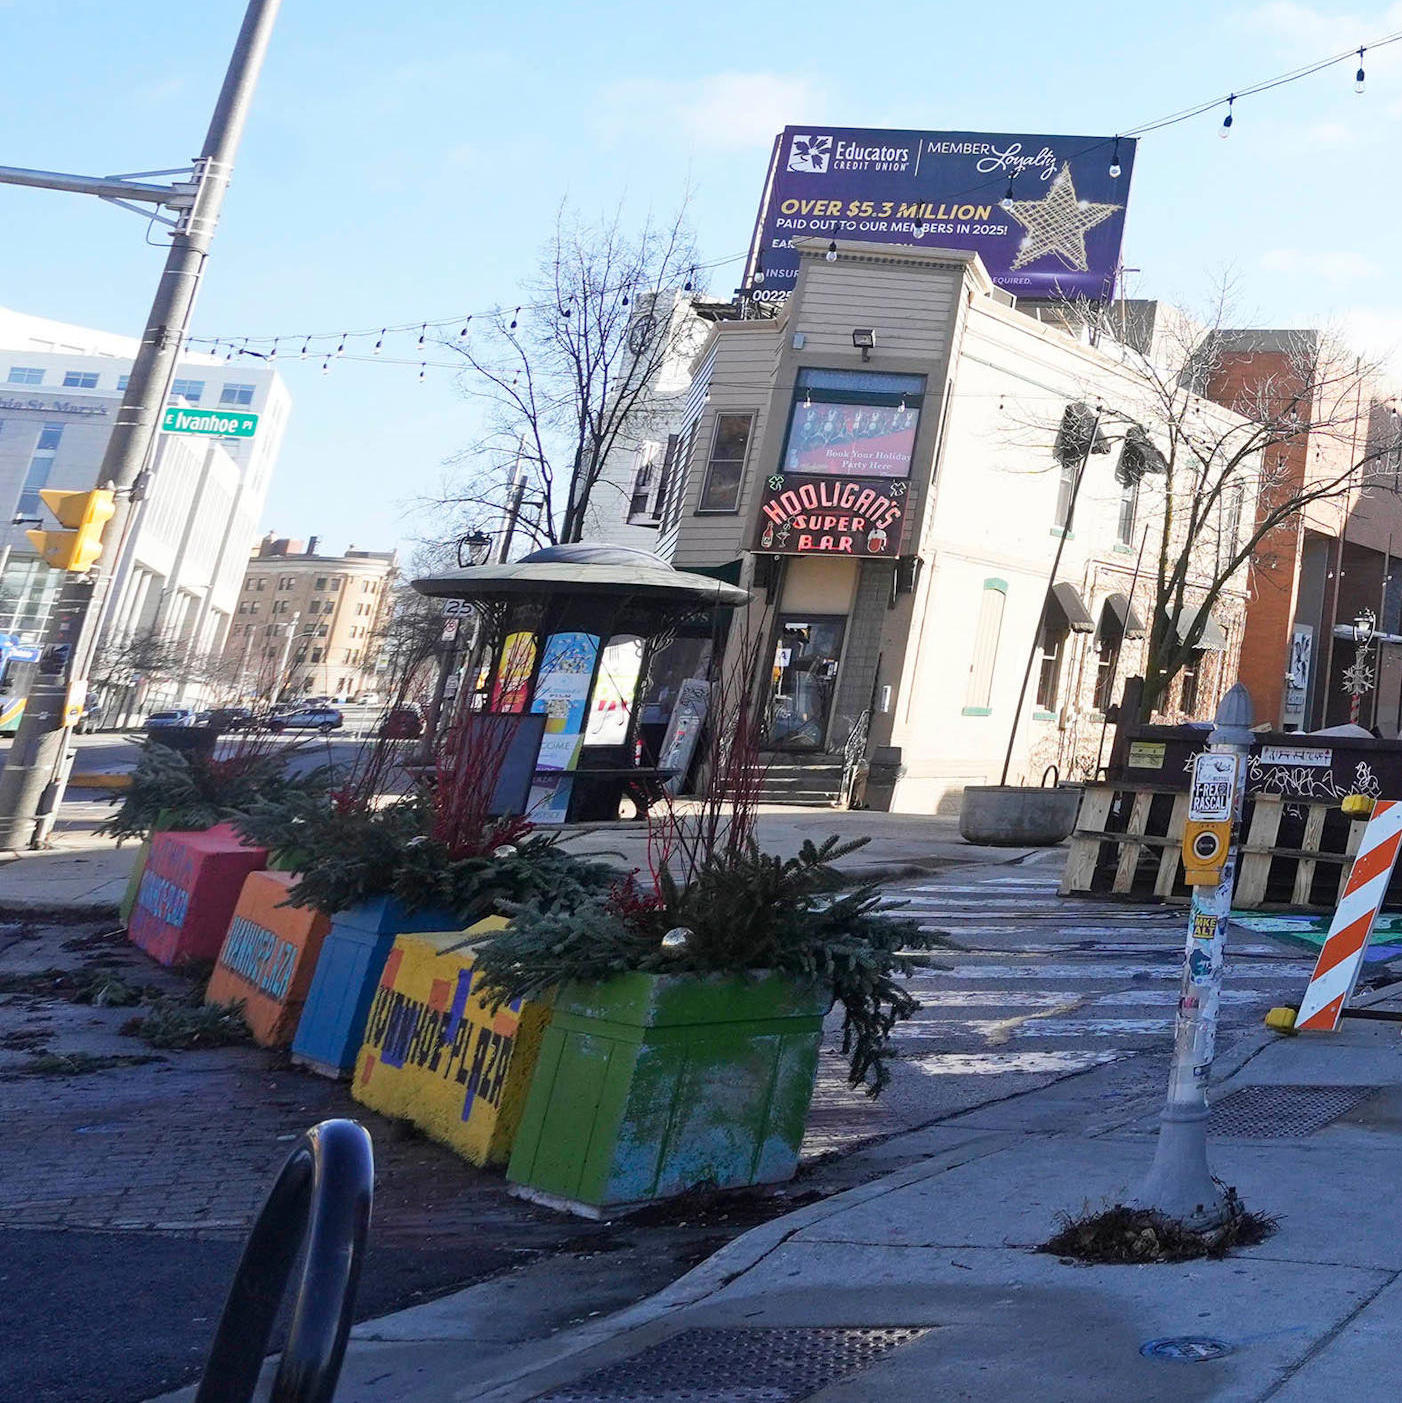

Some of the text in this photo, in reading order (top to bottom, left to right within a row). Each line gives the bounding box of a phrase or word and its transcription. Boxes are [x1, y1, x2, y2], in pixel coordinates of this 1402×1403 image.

[833, 161, 909, 173] CREDIT UNION
[836, 141, 1058, 181] Educators MEMBER Loyalty
[780, 199, 992, 222] OVER $5.3 MILLION
[776, 218, 1008, 236] PAID OUT TO OUR MEMBERS IN 2025!
[165, 411, 254, 433] E Ivanhoe Pl
[826, 449, 912, 463] Book Your Holiday
[841, 461, 892, 471] Party Here
[762, 481, 902, 530] HOOLIGAN'S
[793, 514, 866, 532] SUPER
[797, 534, 854, 554] BAR
[446, 600, 472, 614] 25
[1195, 782, 1220, 797] T-REX
[1193, 796, 1226, 811] RASCAL
[1195, 917, 1217, 928] MKE
[1194, 927, 1215, 936] ALT
